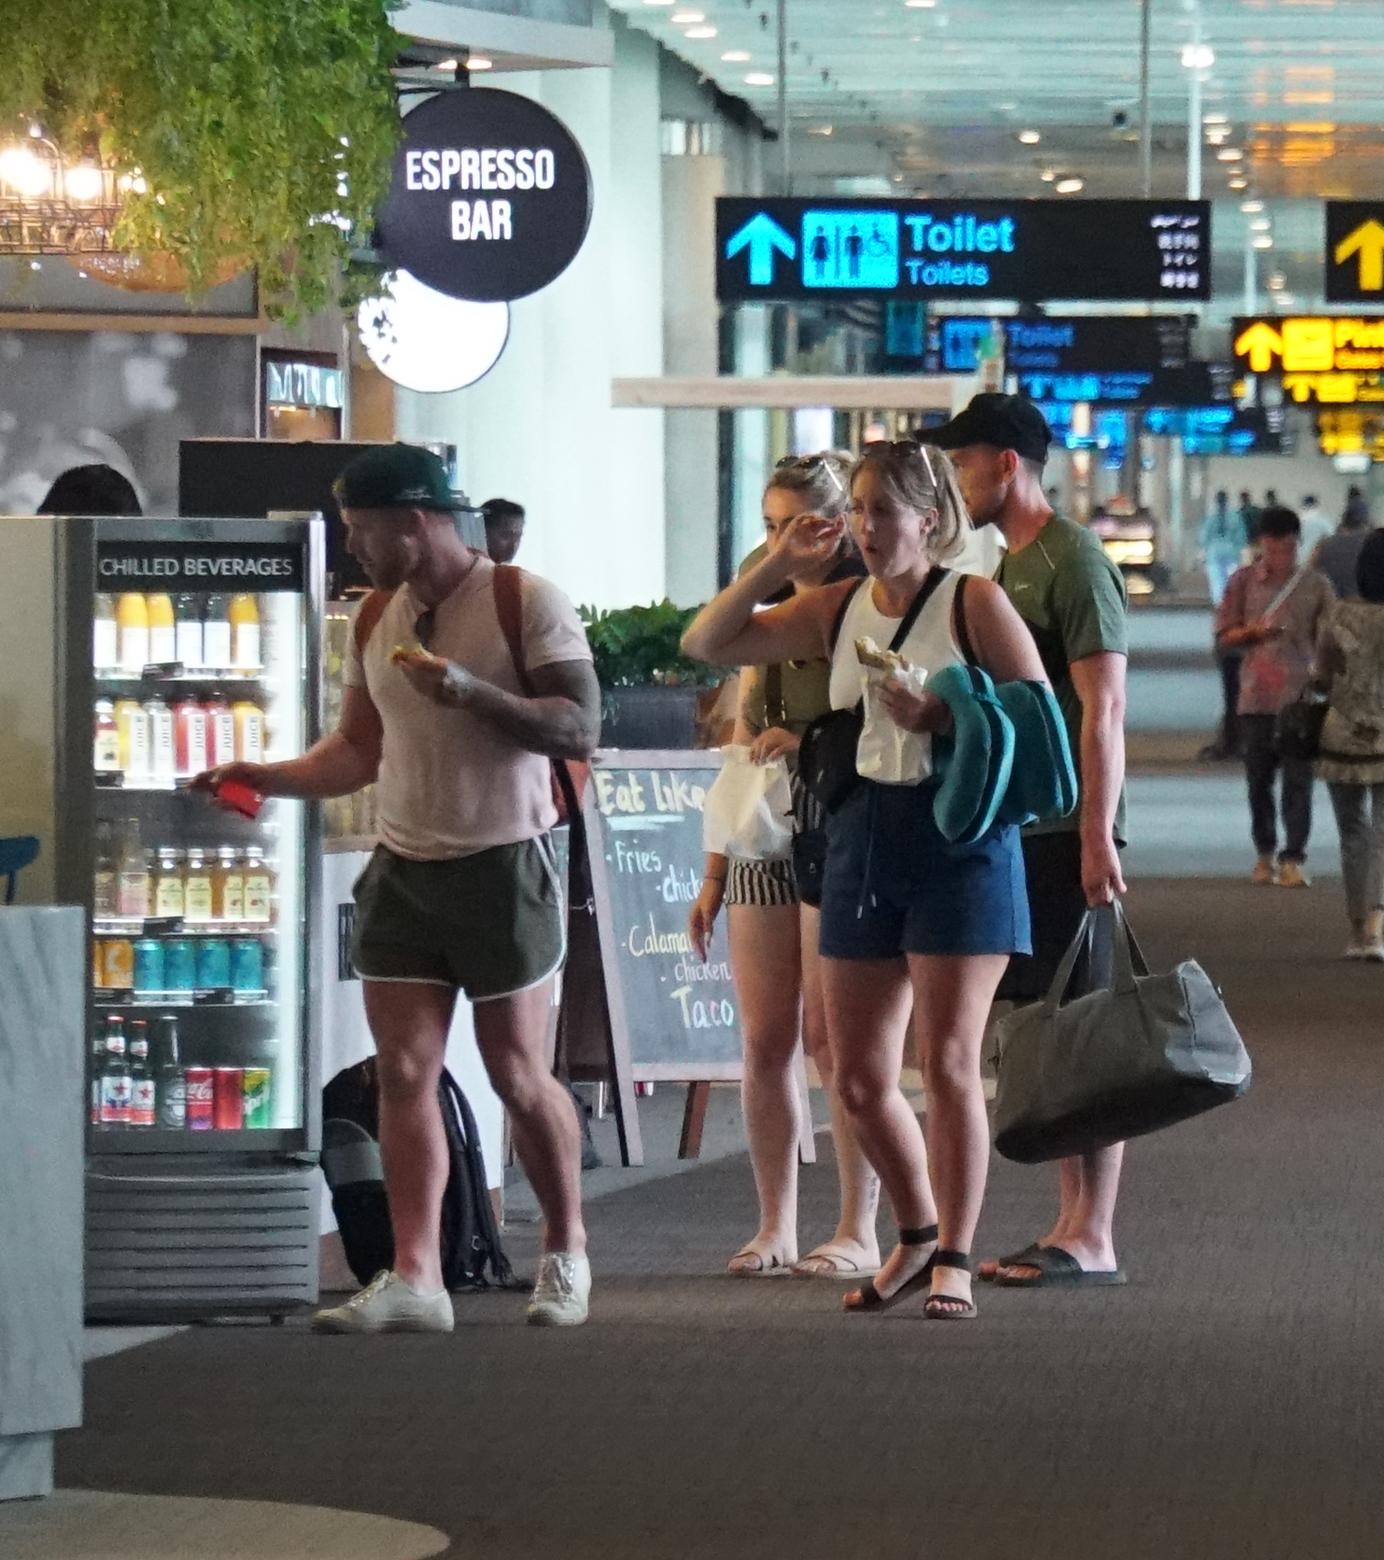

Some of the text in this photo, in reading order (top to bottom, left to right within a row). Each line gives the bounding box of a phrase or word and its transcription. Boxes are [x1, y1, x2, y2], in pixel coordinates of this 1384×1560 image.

[405, 148, 555, 191] ESPRESSO
[450, 198, 512, 241] BAR
[904, 212, 1016, 255] Toilet
[904, 259, 990, 287] Toilets
[99, 558, 293, 576] CHILLED BEVERAGES
[596, 770, 646, 815] Eat
[615, 838, 662, 873] Fries
[669, 984, 735, 1029] Taco
